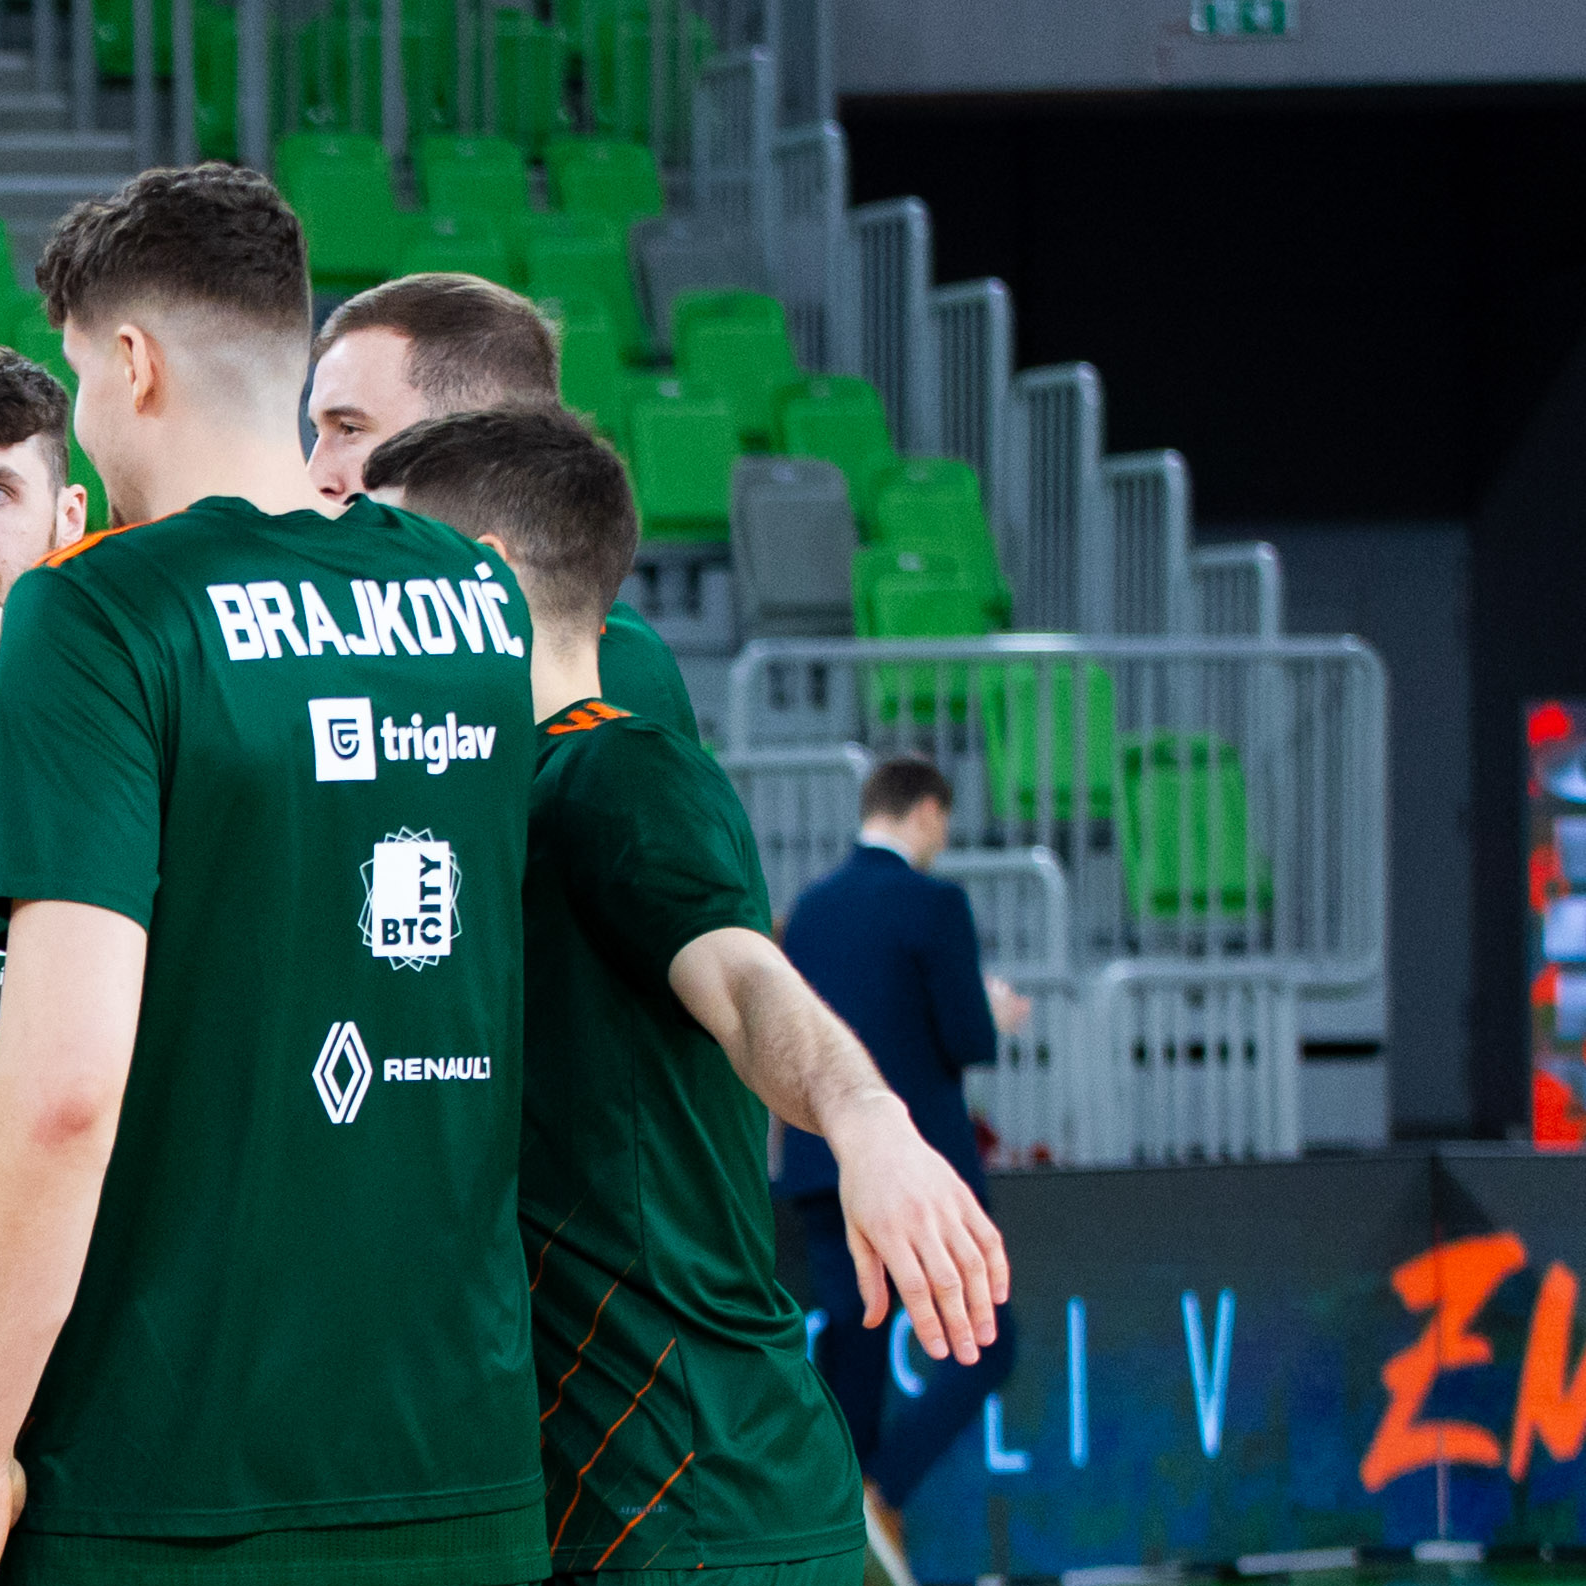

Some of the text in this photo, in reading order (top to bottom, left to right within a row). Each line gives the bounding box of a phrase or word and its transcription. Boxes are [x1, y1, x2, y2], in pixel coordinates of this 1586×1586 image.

[206, 561, 524, 661] BRAJKOVIĆ
[380, 712, 496, 774] triglav
[380, 916, 443, 946] BTC
[383, 1056, 491, 1082] RENAULT
